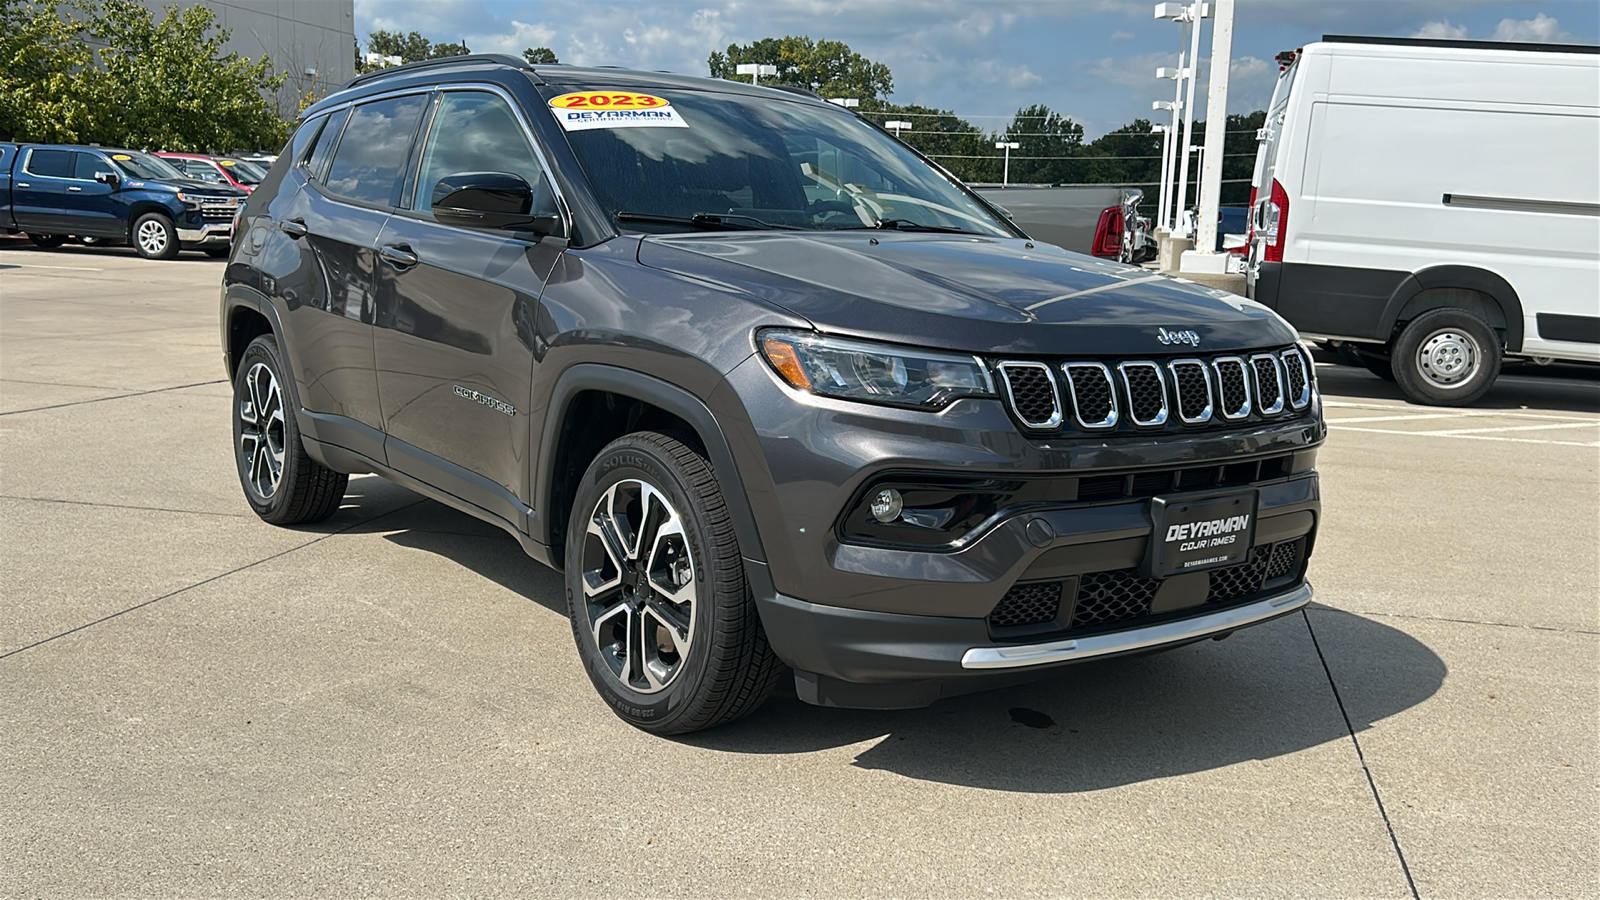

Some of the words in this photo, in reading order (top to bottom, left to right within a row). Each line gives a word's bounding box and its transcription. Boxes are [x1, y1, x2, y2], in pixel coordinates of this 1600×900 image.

[566, 95, 659, 107] 2023
[567, 111, 672, 120] DEYARMAN
[1156, 326, 1200, 347] Jeep
[453, 384, 515, 417] COMPASS
[603, 455, 643, 471] SOLUS
[1165, 514, 1249, 542] DEYARMAN
[1210, 535, 1236, 547] AMES
[1184, 555, 1228, 568] DEYARMANAMES.COM
